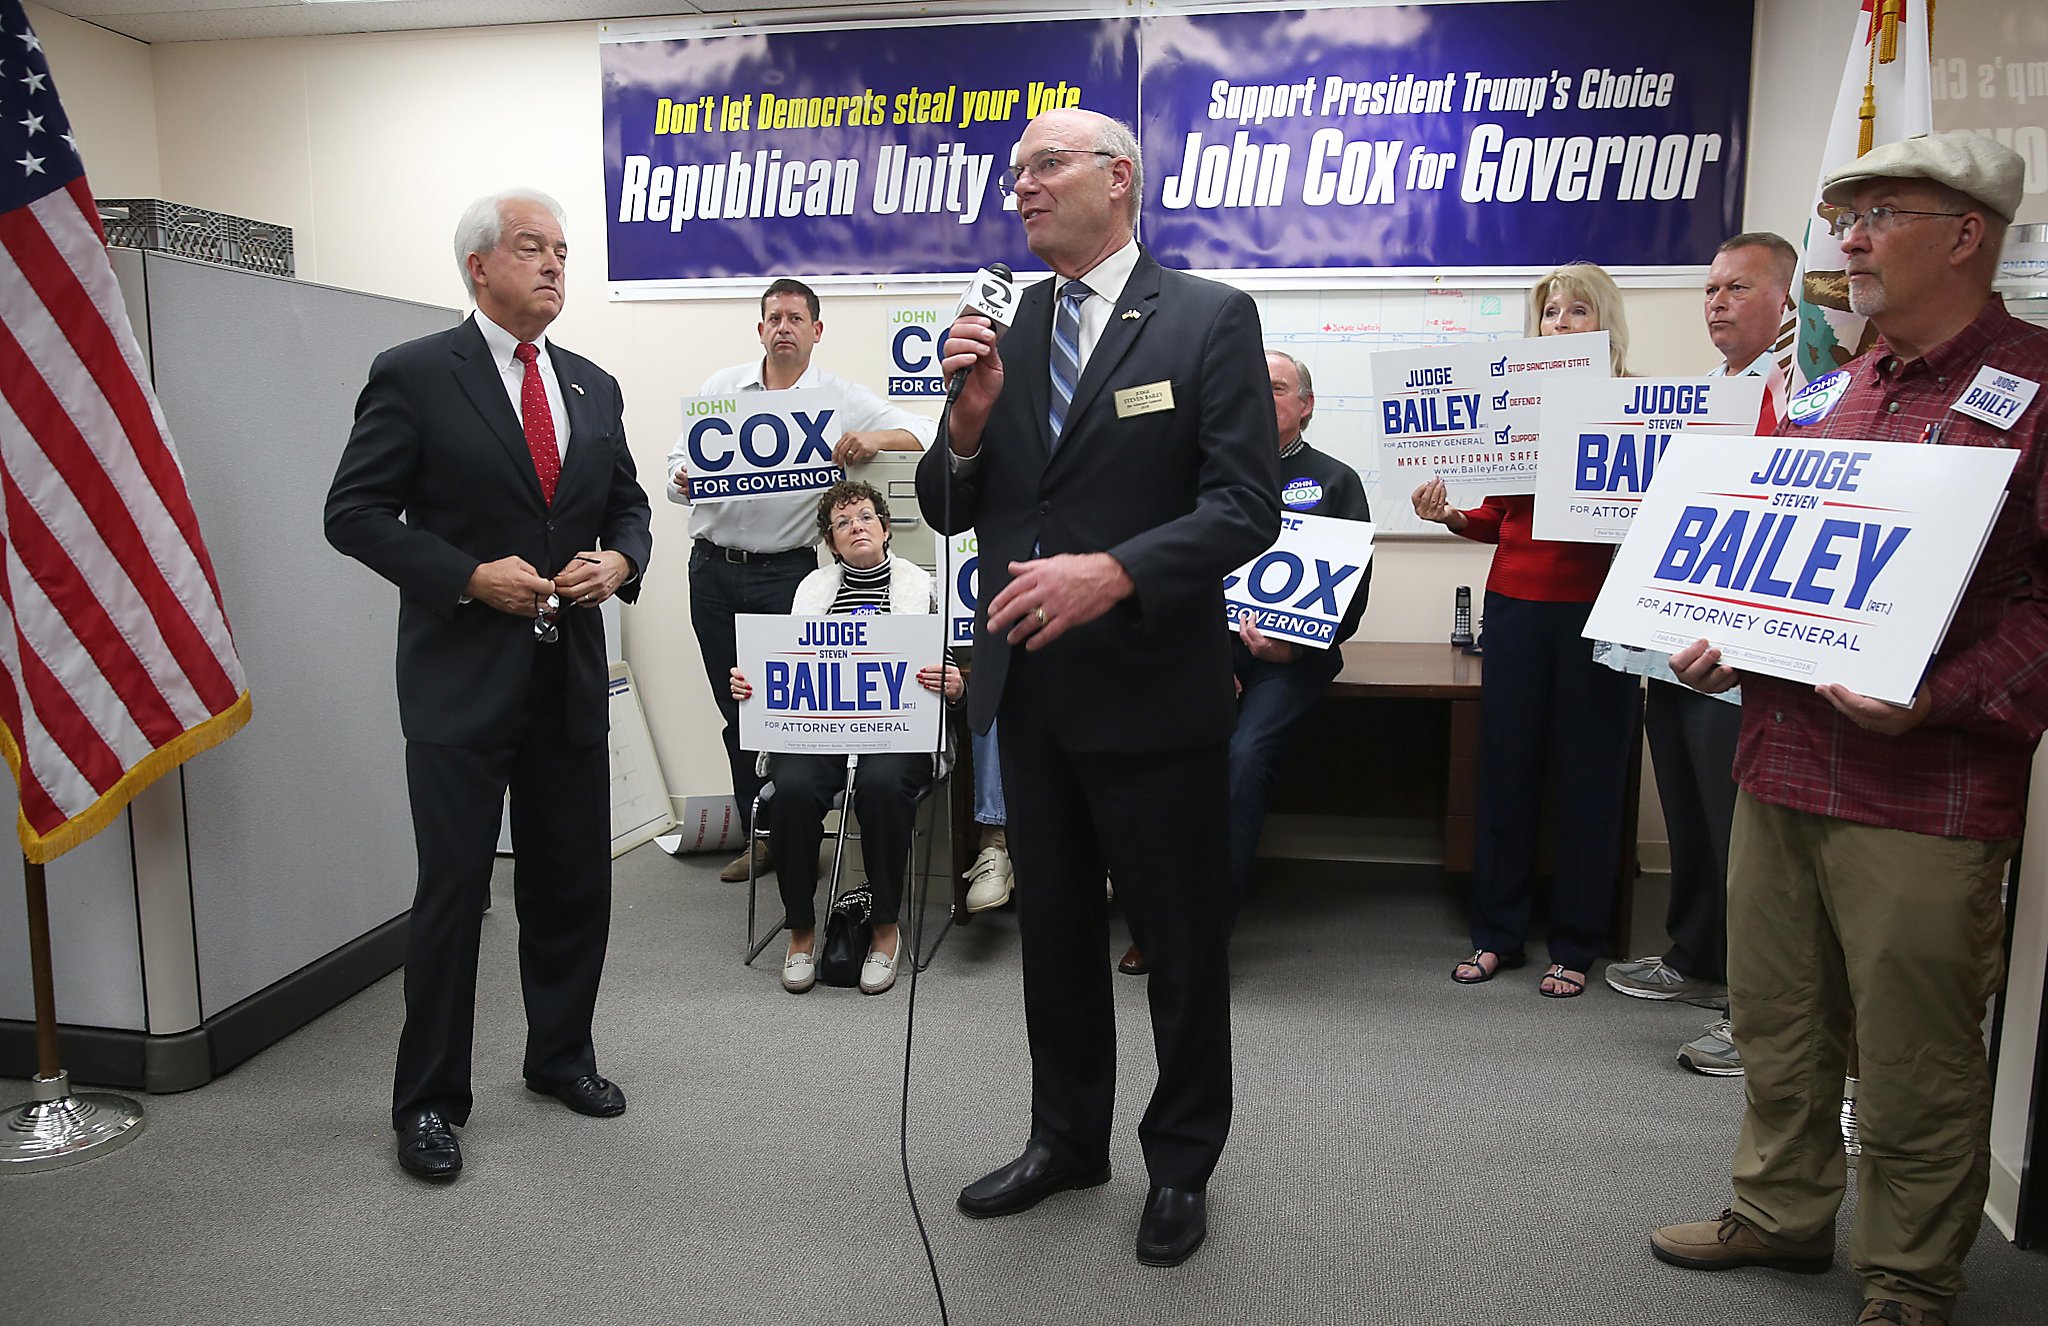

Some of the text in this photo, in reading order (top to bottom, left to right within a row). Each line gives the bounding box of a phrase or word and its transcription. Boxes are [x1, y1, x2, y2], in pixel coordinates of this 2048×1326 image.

[1207, 66, 1676, 125] Support President Trump's Choice
[655, 80, 1082, 135] Don't let Democrats steal your Vote
[1161, 122, 1722, 210] John Cox for Governor
[619, 149, 860, 233] Republican
[872, 142, 995, 224] Unity
[892, 311, 937, 323] JOHN
[978, 301, 1004, 318] KTVU
[1507, 358, 1590, 373] STOP SANCTUARY STATE
[892, 380, 924, 392] FOR
[1405, 367, 1453, 388] JUDGE
[1801, 373, 1842, 397] JOHN
[1992, 376, 2020, 392] JUDGE
[1420, 387, 1441, 396] STEVEN
[1509, 397, 1536, 407] DEFEND
[1624, 385, 1710, 415] JUDGE
[686, 399, 737, 417] JOHN
[1964, 387, 2021, 419] BAILEY
[1382, 393, 1481, 435] BAILEY
[1648, 419, 1683, 430] STEVEN
[688, 409, 836, 472] COX
[1397, 440, 1441, 449] ATTORNEY
[1444, 437, 1485, 446] GENERAL
[1397, 456, 1427, 467] MAKE
[1433, 452, 1503, 465] CALIFORNIA
[1750, 447, 1872, 492] JUDGE
[692, 468, 843, 496] FOR GOVERNOR
[1287, 480, 1313, 490] JOHN
[1284, 487, 1319, 502] COX
[1772, 493, 1819, 509] STEVEN
[1570, 505, 1590, 514] FOR
[1653, 505, 1912, 611] BAILEY
[1223, 551, 1360, 617] OX
[1225, 604, 1333, 639] GOVERNOR
[1637, 597, 1861, 652] FOR ATTORNEY GENERAL
[798, 622, 868, 646] JUDGE
[819, 649, 848, 659] STEVEN
[765, 661, 908, 711] BAILEY
[764, 721, 910, 733] FOR ATTORNEY GENERAL
